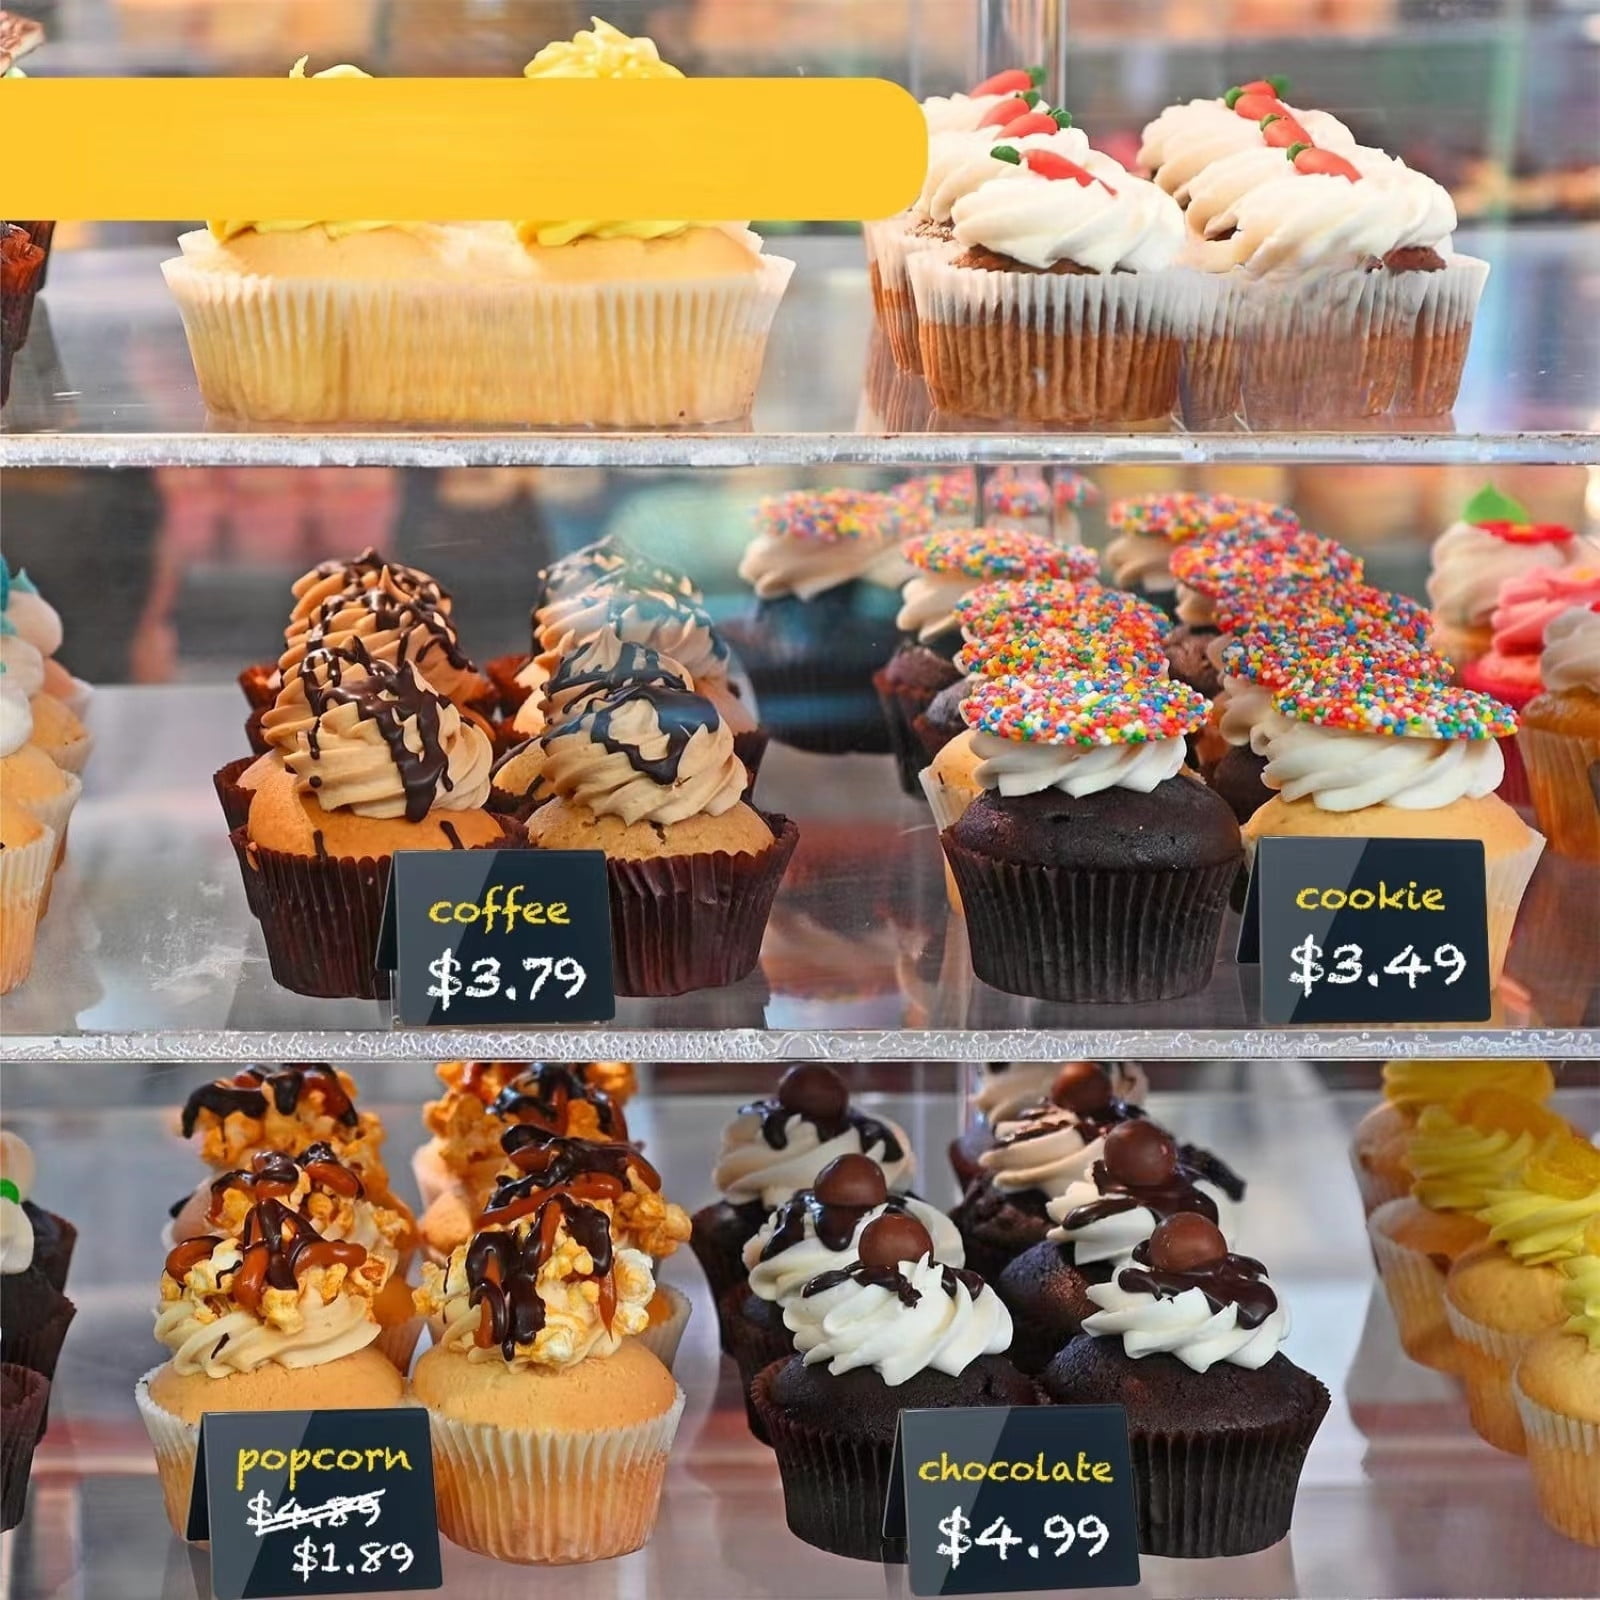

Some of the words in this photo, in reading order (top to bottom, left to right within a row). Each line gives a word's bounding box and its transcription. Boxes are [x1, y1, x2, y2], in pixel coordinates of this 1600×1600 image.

[428, 885, 570, 934] coffee
[1296, 880, 1446, 911] cookie
[426, 948, 586, 1010] $3.79
[1288, 934, 1466, 997] $3.49
[236, 1447, 413, 1491] popcorn
[919, 1452, 1114, 1482] chocolate
[292, 1535, 414, 1582] $1.89
[936, 1506, 1109, 1569] $4.99
